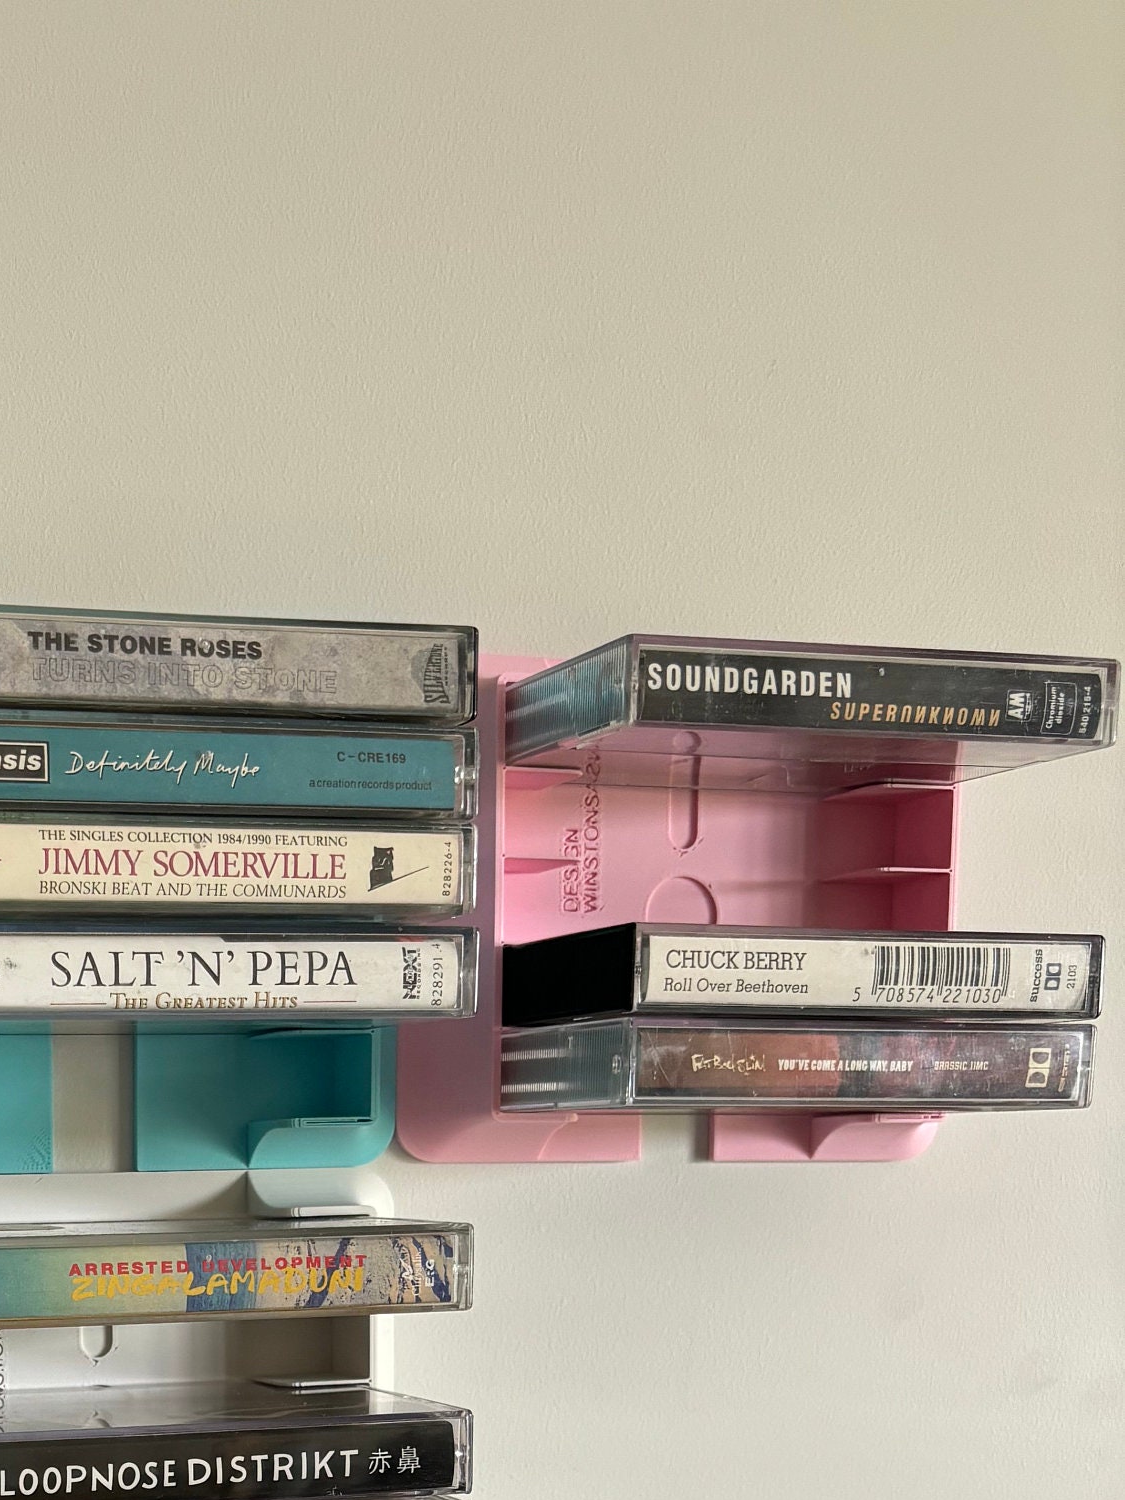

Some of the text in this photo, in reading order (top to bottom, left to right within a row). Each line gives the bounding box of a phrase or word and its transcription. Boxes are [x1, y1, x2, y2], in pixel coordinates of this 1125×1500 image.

[28, 631, 262, 660] THE STONE ROSES
[647, 663, 851, 698] SOUNDGARDEN
[1045, 687, 1057, 729] Chromium
[39, 829, 348, 847] THE SINGLES COLLECTION 1984/1990 FEATURING
[38, 847, 347, 880] JIMMY SOMERVILLE
[442, 841, 452, 896] 828226-4
[39, 881, 347, 898] BRONSKI BEAT AND THE COMMUNARDS
[51, 950, 358, 987] SALT PEPA
[666, 949, 807, 971] CHUCK BERRY
[663, 978, 809, 994] Roll Over Beethoven
[1030, 948, 1043, 1002] success
[1066, 965, 1077, 989] 2103
[852, 987, 861, 1002] 5
[778, 1059, 913, 1072] YOU'VE COME LONG WAY, BABY
[68, 1254, 368, 1277] ARRESTED DEVELOPMENT
[0, 1450, 359, 1497] LOOPNOSE DISTRIKT
[368, 1446, 421, 1475] 赤鼻
